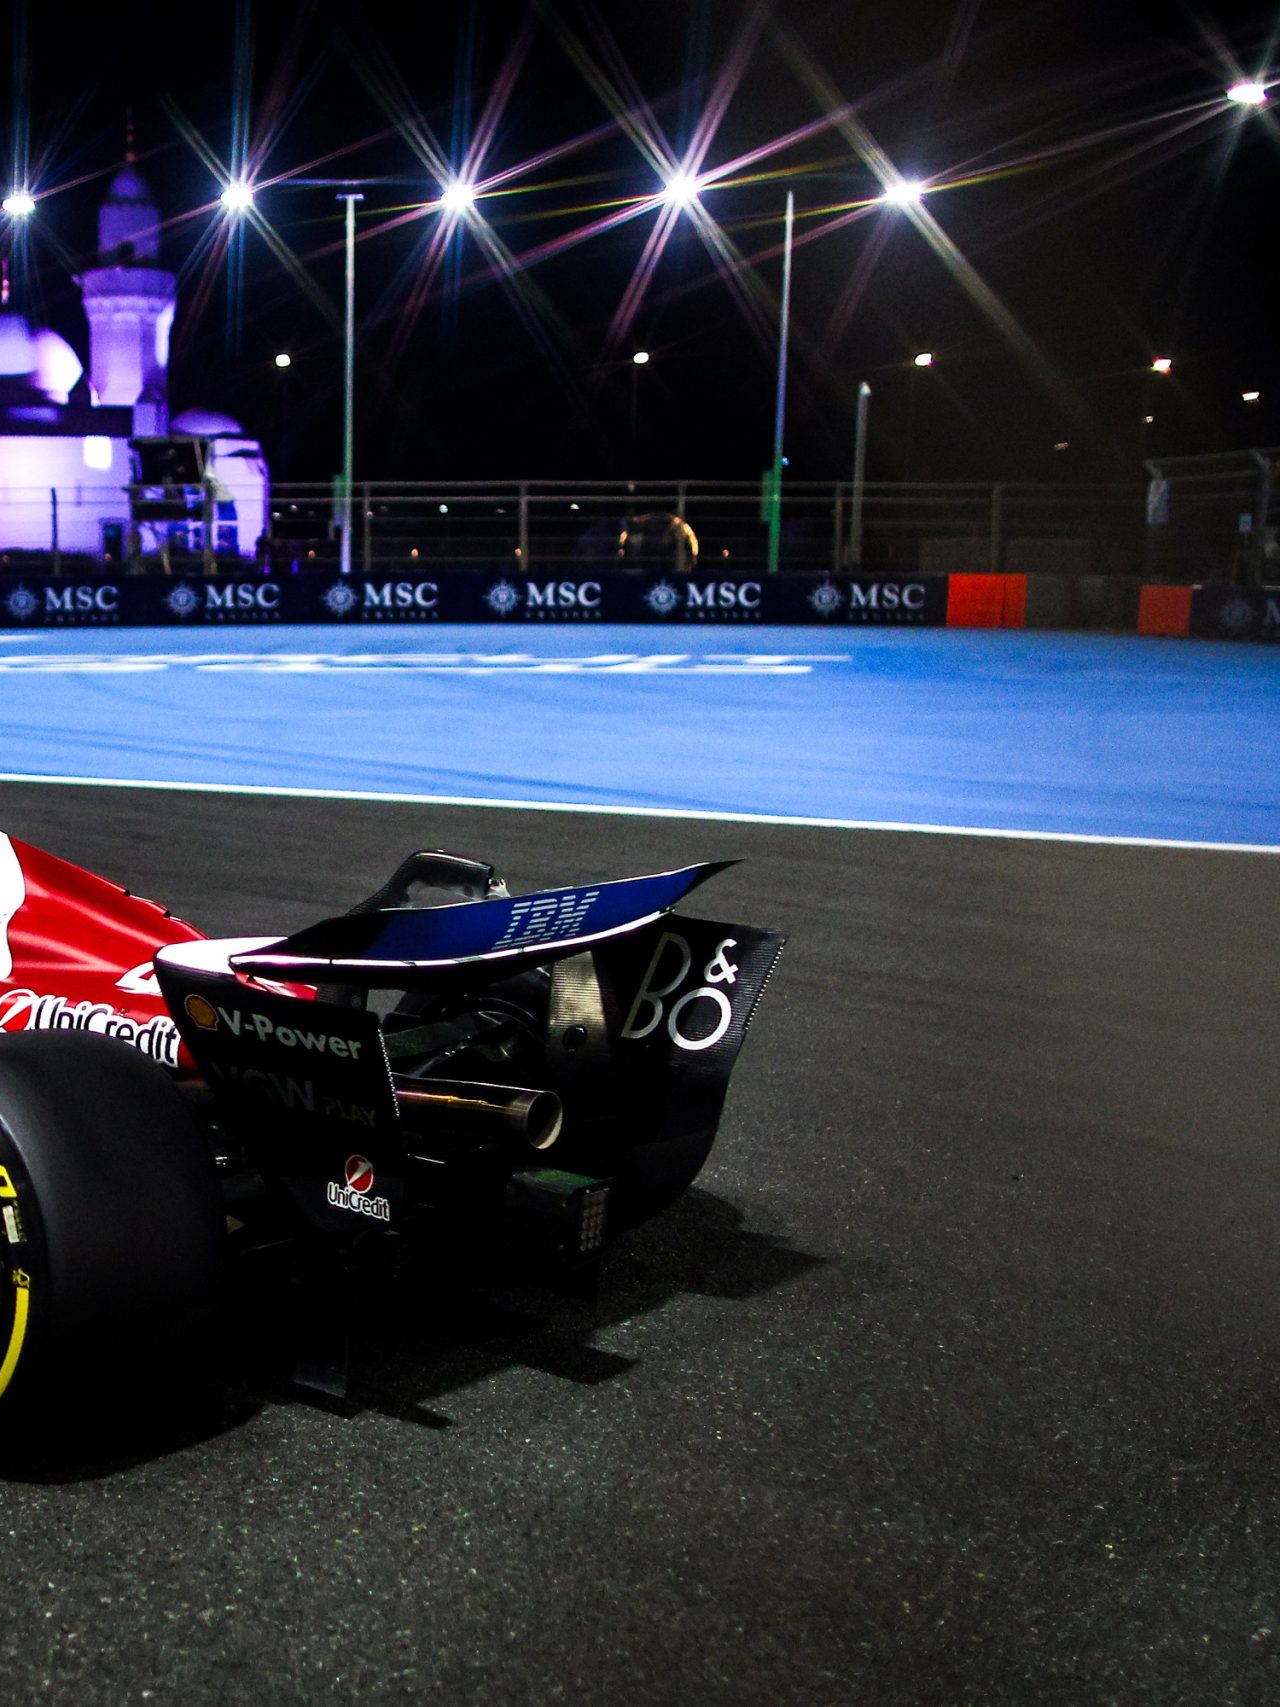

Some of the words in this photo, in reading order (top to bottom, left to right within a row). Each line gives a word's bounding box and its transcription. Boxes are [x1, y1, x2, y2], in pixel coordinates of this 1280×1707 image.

[43, 585, 120, 611] MSC
[204, 583, 281, 609] MSC
[362, 582, 439, 608] MSC
[525, 581, 602, 608] MSC
[685, 581, 762, 608] MSC
[849, 582, 926, 610] MSC
[490, 891, 600, 950] IBM
[33, 997, 179, 1067] UniCredit
[217, 1006, 363, 1060] V-Power
[327, 1181, 390, 1222] UniCredit
